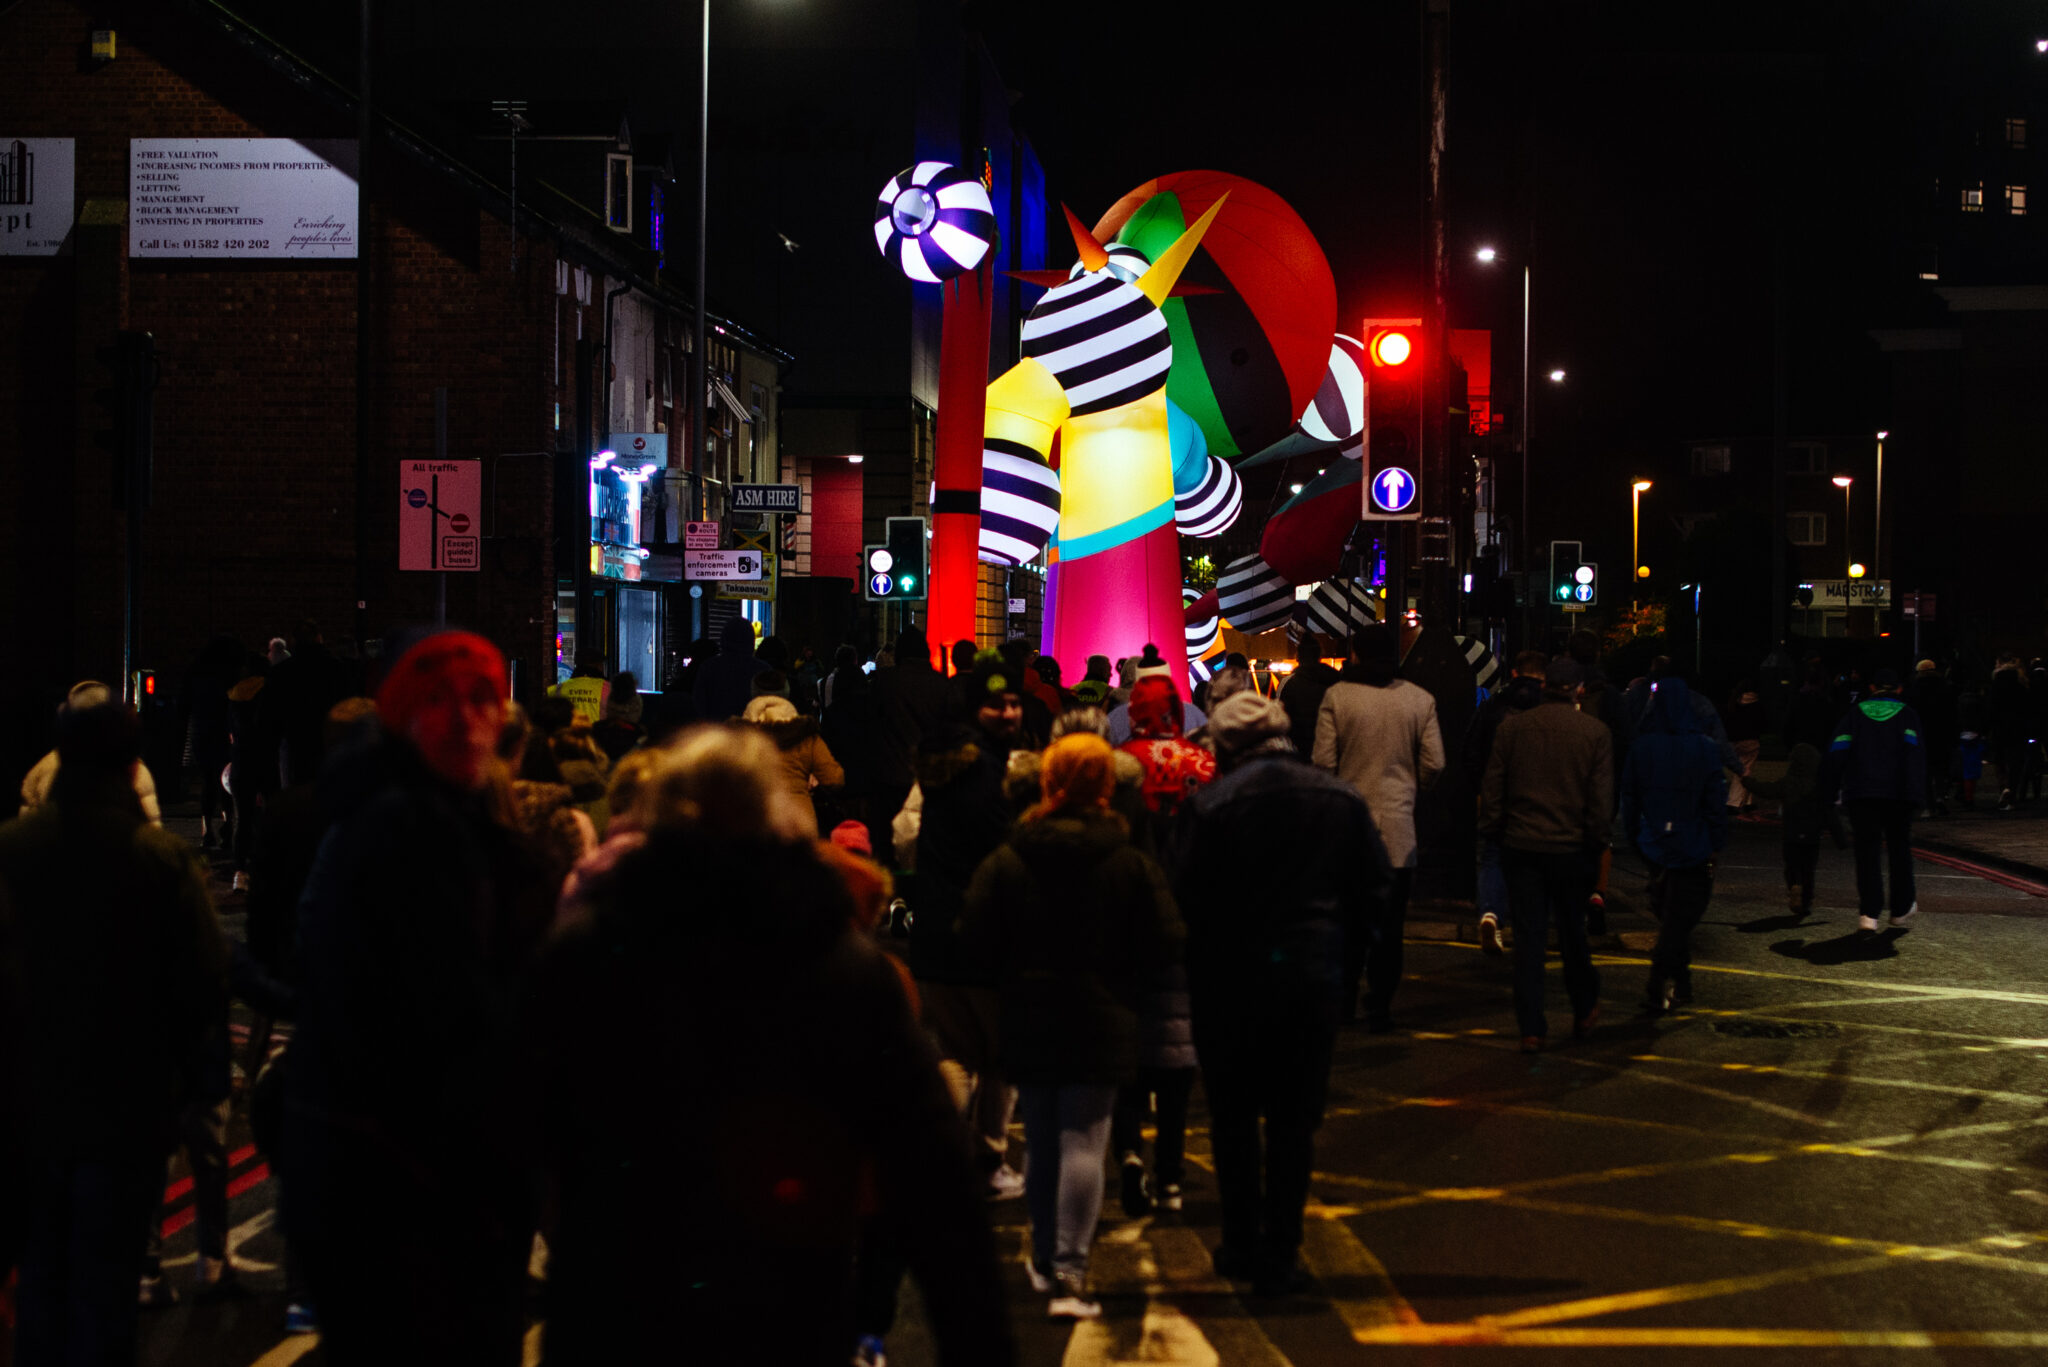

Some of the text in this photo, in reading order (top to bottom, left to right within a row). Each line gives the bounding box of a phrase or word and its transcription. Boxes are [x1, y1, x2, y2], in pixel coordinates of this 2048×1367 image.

[142, 151, 218, 159] FREE VALUATION
[142, 162, 332, 170] INCREASING INCOMES FROM PROPERTIES
[141, 173, 179, 181] SELLING
[141, 184, 181, 192] LETTING
[141, 195, 205, 203] MANAGEMENT
[141, 206, 240, 214] BLOCK MANAGEMENT
[141, 217, 264, 225] INVESTING IN PROPERTIES
[294, 214, 346, 237] Enriching
[139, 239, 270, 249] Call Us: 01582 420 202
[413, 463, 459, 472] All traffic
[735, 489, 797, 507] ASM HIRE
[447, 540, 474, 549] Except
[447, 548, 473, 557] guided
[448, 556, 472, 564] buses
[699, 553, 725, 561] Traffic
[687, 561, 737, 569] enforcement
[695, 570, 728, 578] cameras
[726, 584, 769, 596] Takeaway
